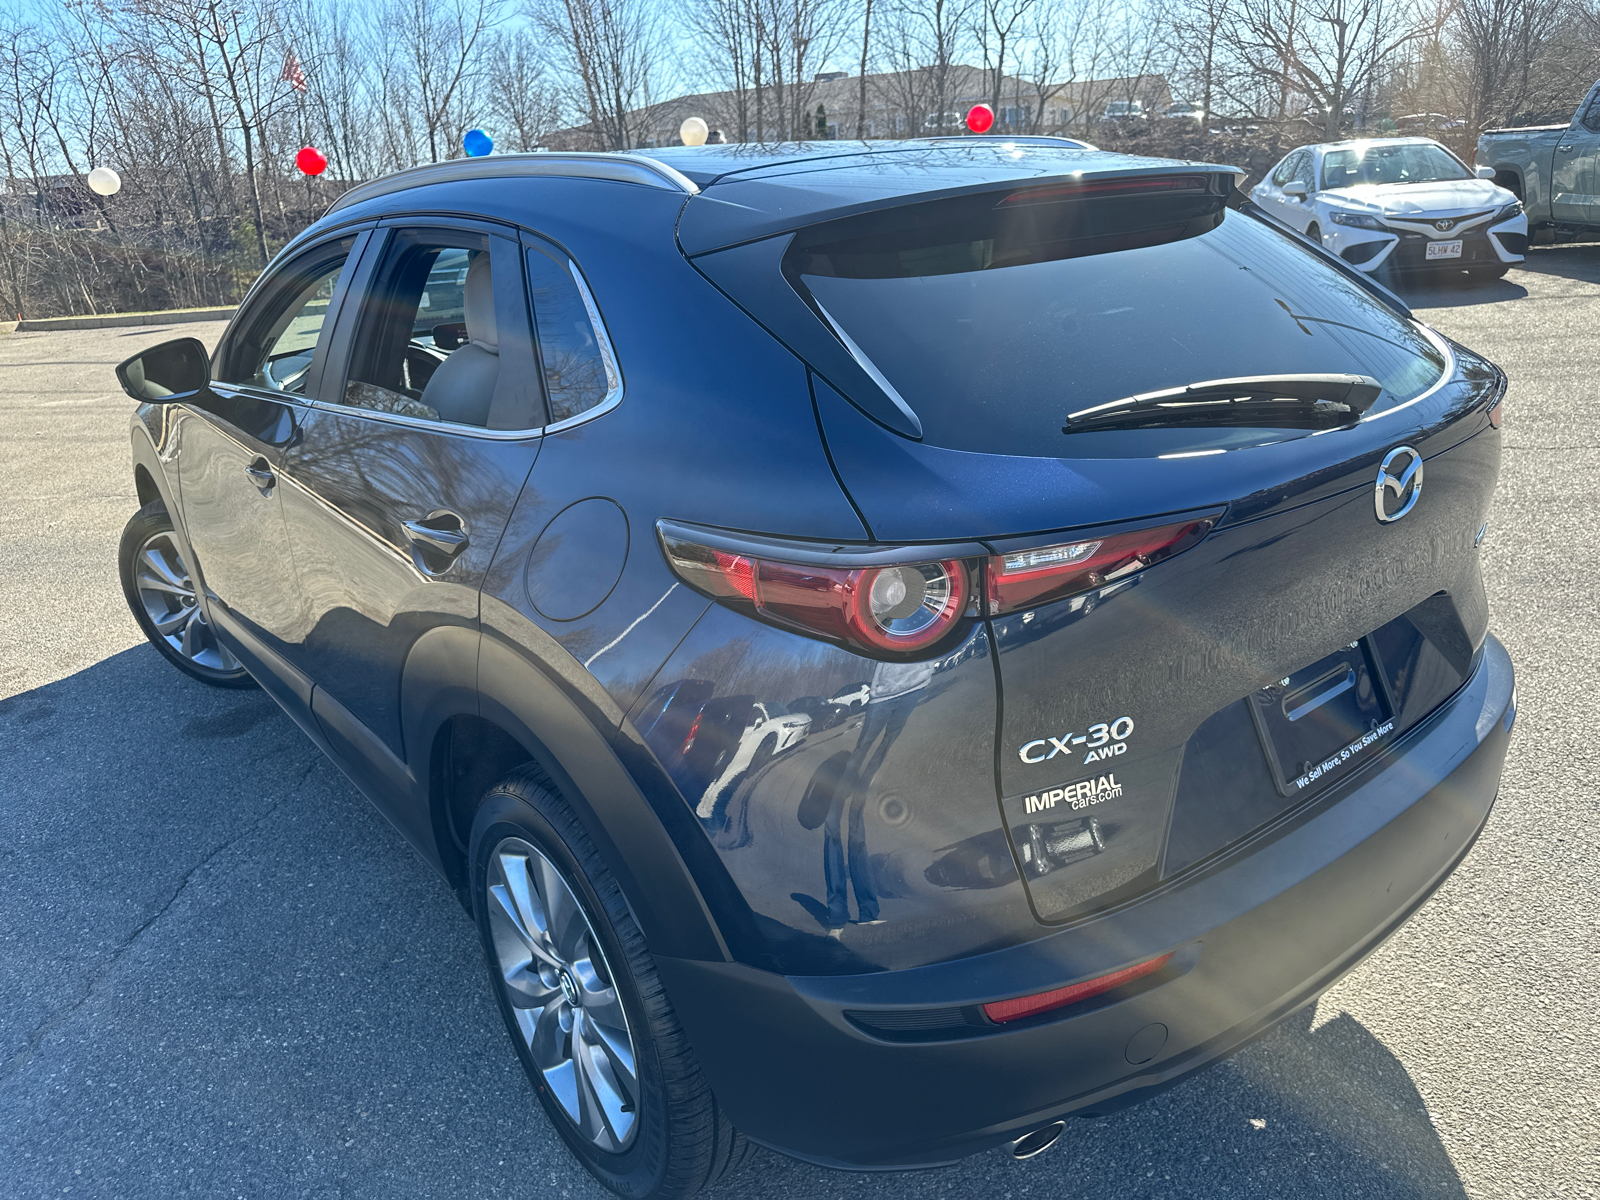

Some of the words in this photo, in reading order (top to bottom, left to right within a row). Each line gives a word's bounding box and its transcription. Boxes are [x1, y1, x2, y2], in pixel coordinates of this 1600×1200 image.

[1450, 244, 1461, 254] 42
[1018, 716, 1134, 764] CX-30
[1083, 741, 1128, 765] AWD
[1296, 775, 1309, 789] We
[1308, 766, 1322, 781] Sell
[1322, 757, 1342, 773] More,
[1340, 750, 1350, 761] So
[1349, 742, 1363, 754] You
[1362, 731, 1377, 746] Save
[1376, 722, 1394, 737] More
[1024, 773, 1122, 814] IMPERIAL
[1071, 786, 1123, 811] cars.com
